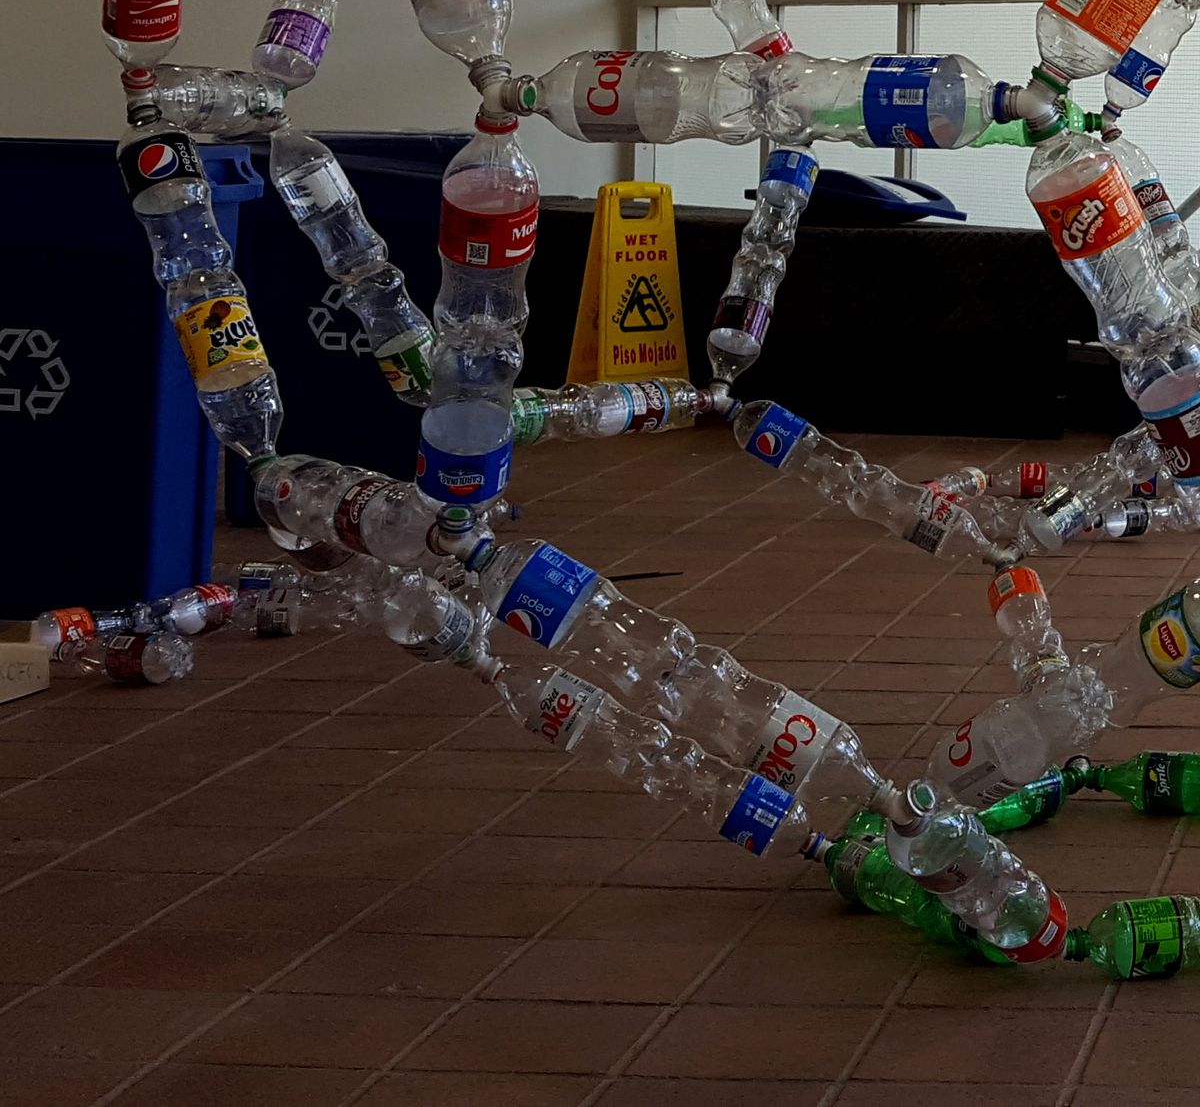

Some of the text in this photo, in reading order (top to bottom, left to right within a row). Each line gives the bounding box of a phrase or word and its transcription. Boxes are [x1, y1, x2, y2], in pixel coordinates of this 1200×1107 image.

[586, 51, 635, 116] Cok
[174, 142, 196, 173] pepsi
[625, 235, 658, 246] WET
[1062, 198, 1106, 250] Crush
[615, 251, 668, 263] FLOOR
[611, 273, 637, 324] Cuidado
[649, 273, 675, 321] Caution
[209, 315, 257, 349] anta
[613, 341, 677, 366] Piso Mojado
[767, 421, 791, 436] pepsi
[516, 593, 554, 617] pepsi
[1159, 626, 1179, 658] Lipton
[541, 693, 576, 744] oke
[1157, 763, 1171, 797] Sprite
